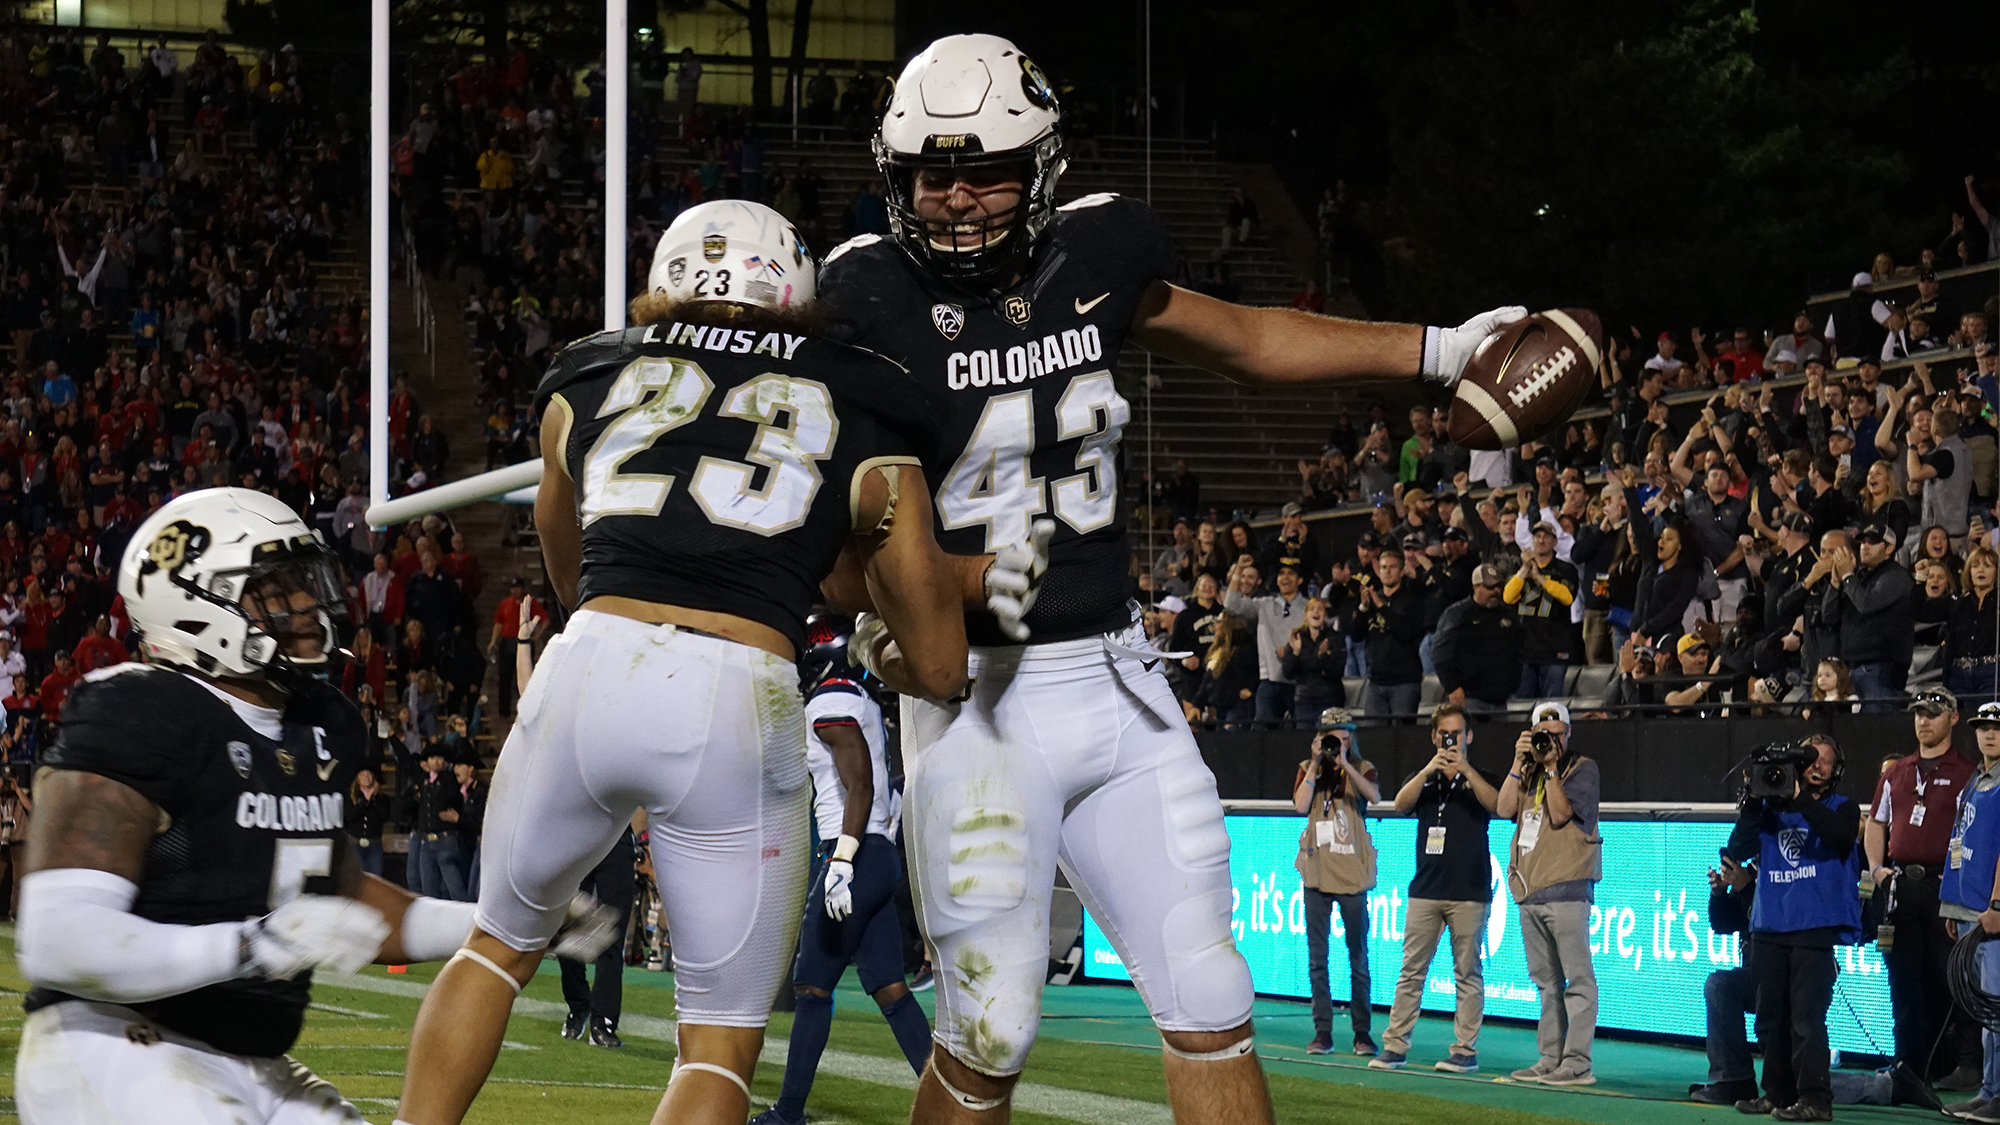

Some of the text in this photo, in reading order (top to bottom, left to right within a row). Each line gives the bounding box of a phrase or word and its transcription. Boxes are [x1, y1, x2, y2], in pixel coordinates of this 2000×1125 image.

[936, 136, 966, 148] BUFFS
[694, 269, 731, 296] 23
[643, 322, 806, 361] LINDSAY
[942, 319, 958, 333] 12
[947, 323, 1103, 391] COLORADO
[580, 355, 840, 538] 23
[935, 369, 1131, 555] 43
[235, 791, 344, 832] COLORADO
[1787, 847, 1801, 860] 12
[1250, 871, 1284, 934] it's
[1589, 904, 1642, 971] ere,
[1653, 889, 1699, 963] it's
